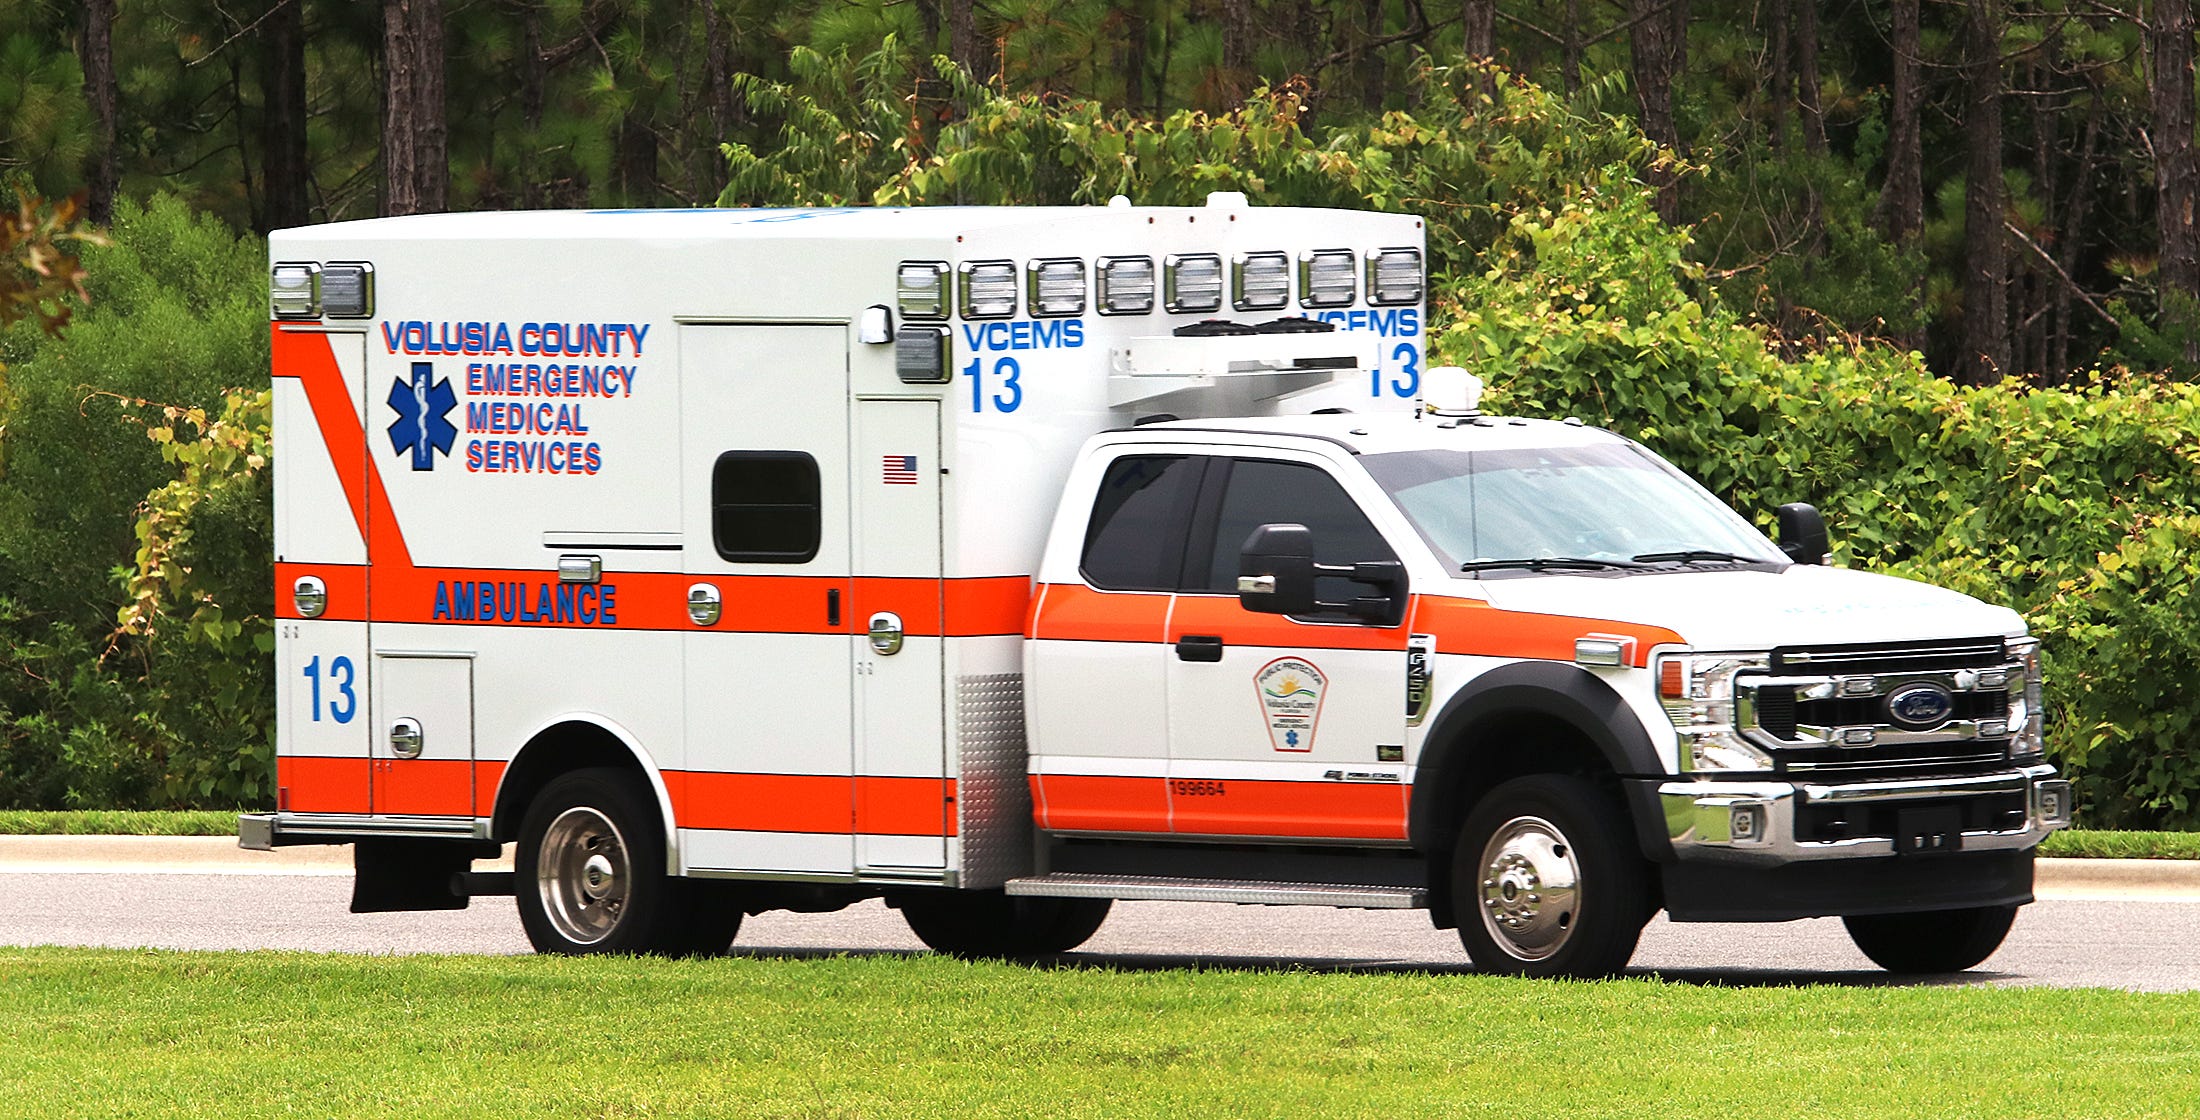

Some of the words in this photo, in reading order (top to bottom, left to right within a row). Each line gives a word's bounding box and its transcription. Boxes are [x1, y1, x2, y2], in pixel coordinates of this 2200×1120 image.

[380, 321, 514, 356] VOLUSIA
[518, 323, 650, 358] COUNTY
[963, 319, 1084, 352] VCEMS
[466, 363, 636, 398] EMERGENCY
[963, 357, 1022, 413] 13
[466, 402, 589, 436] MEDICAL
[465, 440, 602, 476] SERVICES
[433, 581, 616, 624] AMBULANCE
[304, 656, 356, 723] 13
[1283, 662, 1322, 685] PROTECTION
[1905, 696, 1939, 716] Ford
[1169, 781, 1225, 796] 199664
